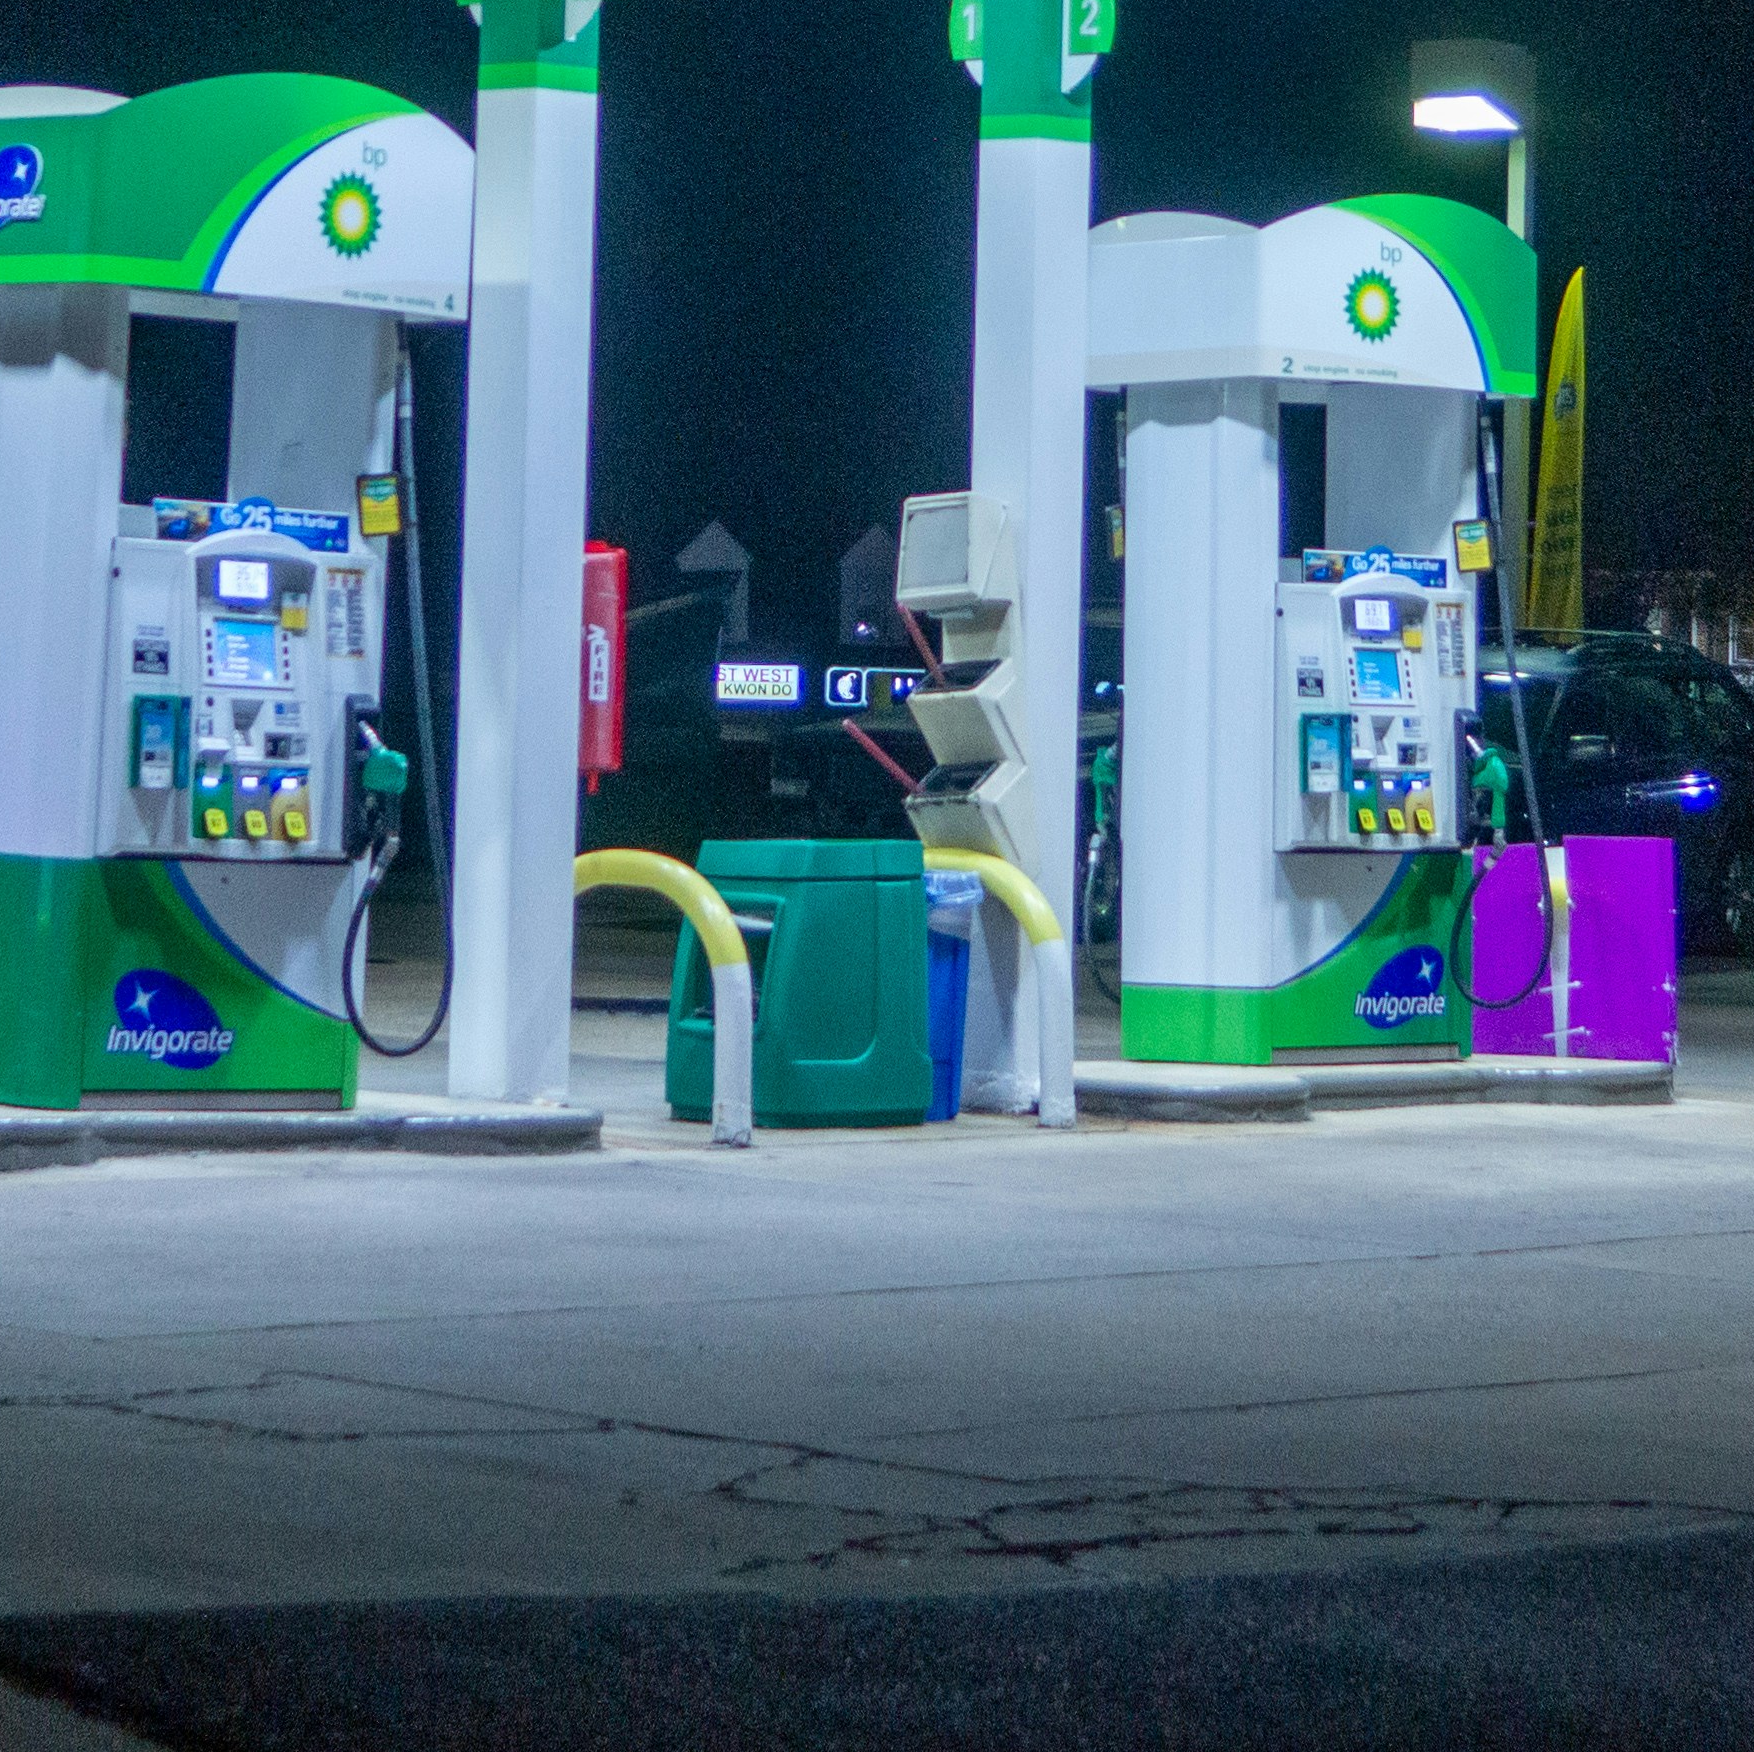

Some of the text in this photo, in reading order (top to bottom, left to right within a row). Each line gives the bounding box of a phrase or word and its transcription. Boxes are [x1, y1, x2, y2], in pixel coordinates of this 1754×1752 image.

[962, 4, 977, 41] 1
[362, 141, 388, 169] bp
[1380, 241, 1402, 267] bp
[444, 294, 454, 312] 4
[1282, 357, 1293, 374] 2
[220, 507, 243, 526] Go
[242, 505, 273, 531] 25
[1351, 556, 1368, 572] Go
[1368, 553, 1391, 574] 25
[745, 668, 793, 683] WEST
[723, 683, 792, 696] KWON DO
[1354, 991, 1445, 1022] Invigorate
[106, 1023, 235, 1060] Invigorate
